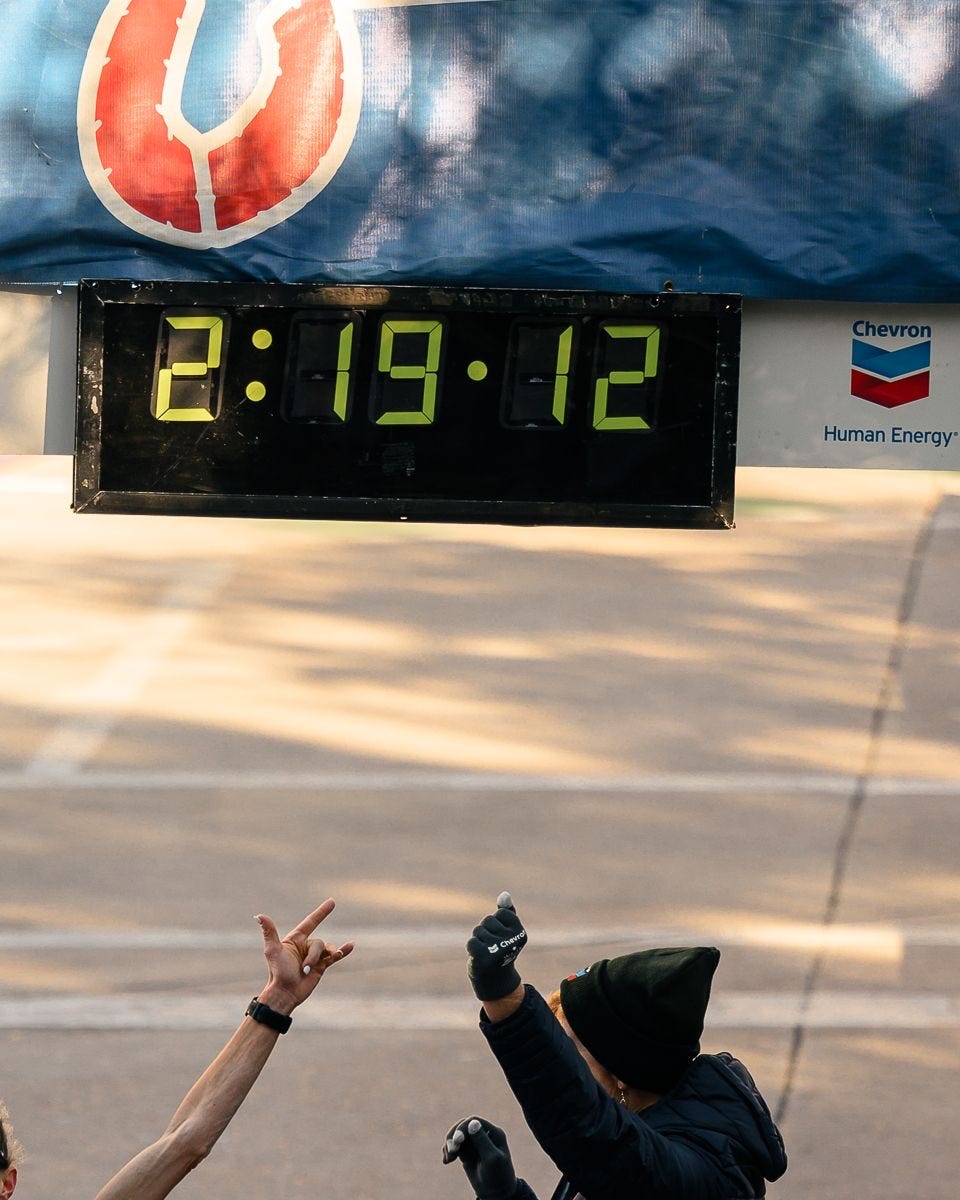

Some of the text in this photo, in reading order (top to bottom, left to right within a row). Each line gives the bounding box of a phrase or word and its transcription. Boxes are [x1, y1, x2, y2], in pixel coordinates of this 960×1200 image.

[852, 319, 932, 339] Chevron
[823, 424, 886, 445] Human
[500, 930, 527, 948] Chevro
